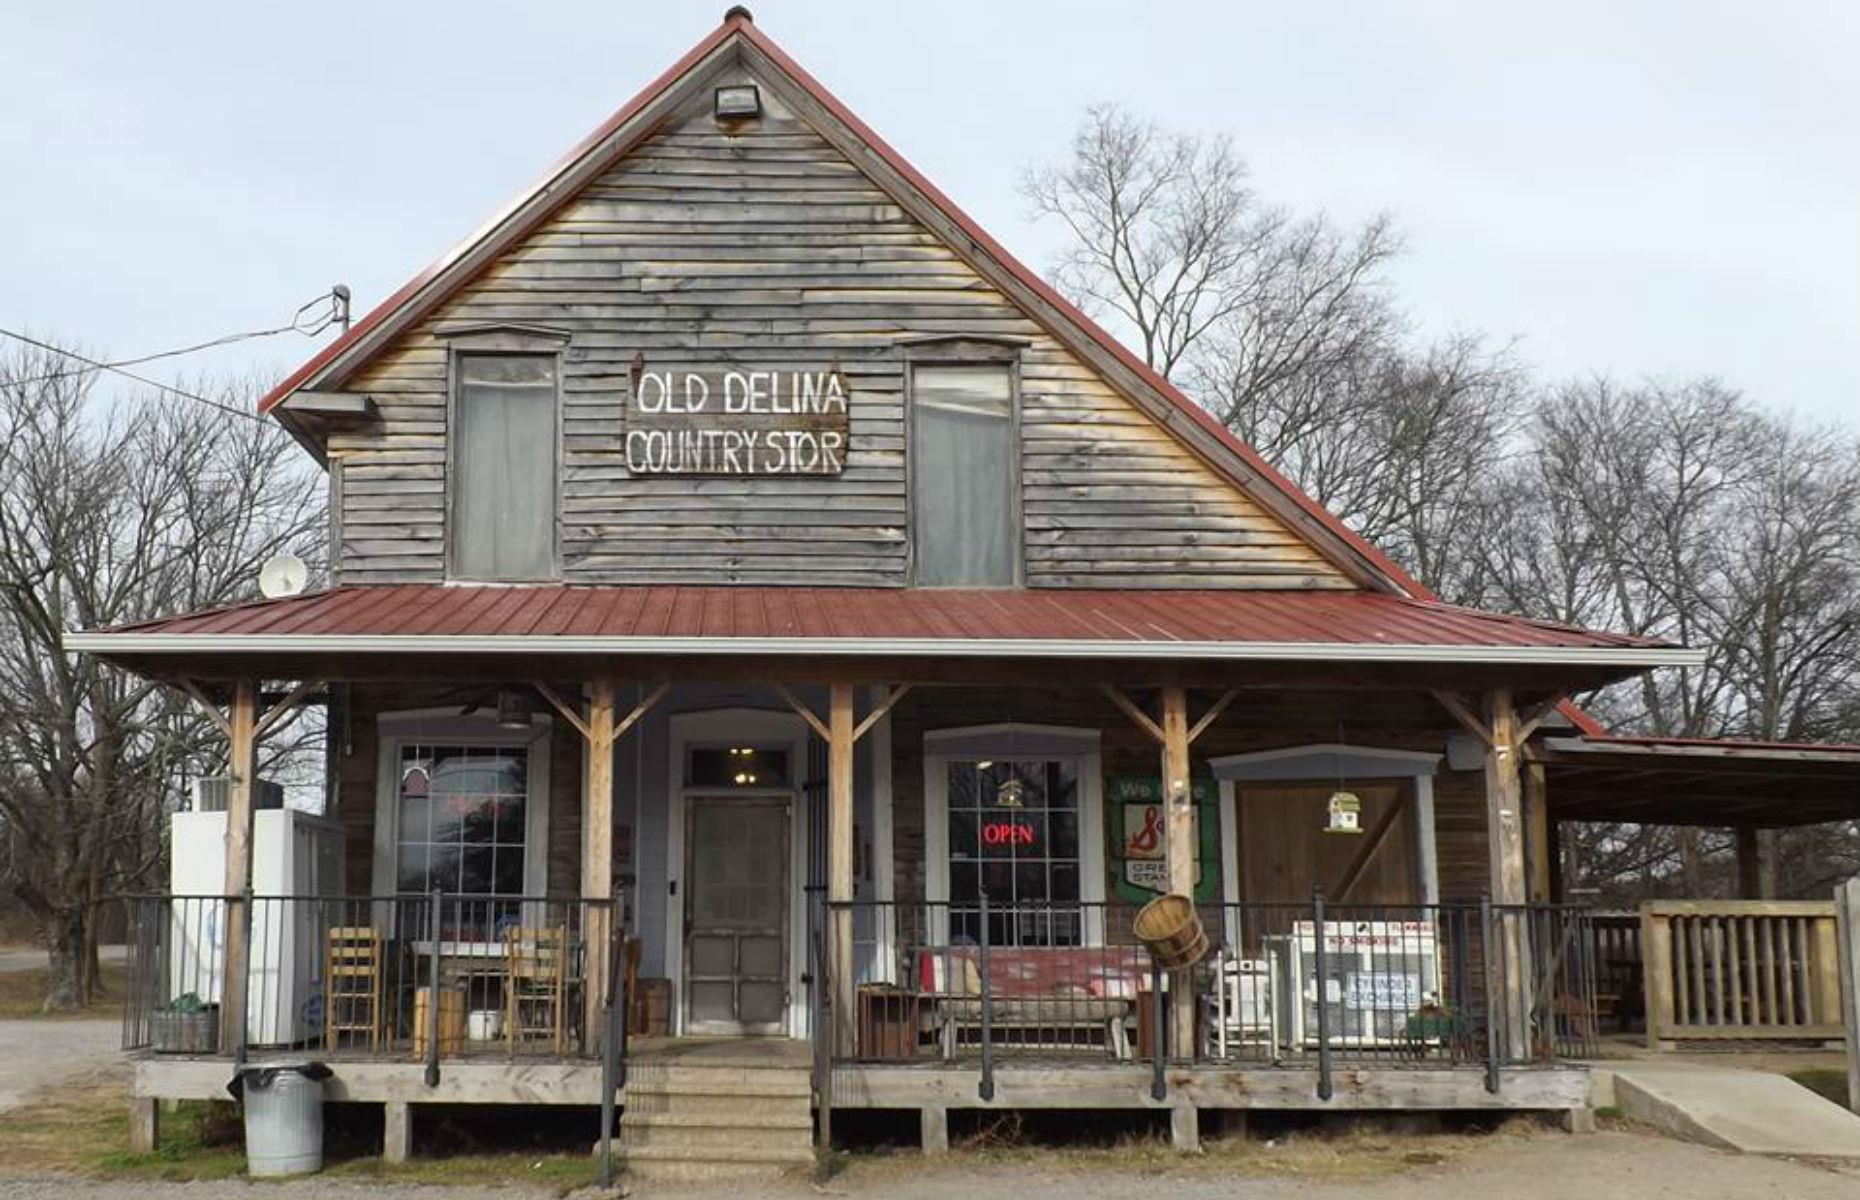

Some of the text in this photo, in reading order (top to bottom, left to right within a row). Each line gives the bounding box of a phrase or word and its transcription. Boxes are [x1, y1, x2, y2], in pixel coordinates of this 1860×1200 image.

[638, 371, 847, 413] OLD DELINA
[626, 429, 842, 473] COUNTRY STOR
[984, 824, 1033, 843] OPEN
